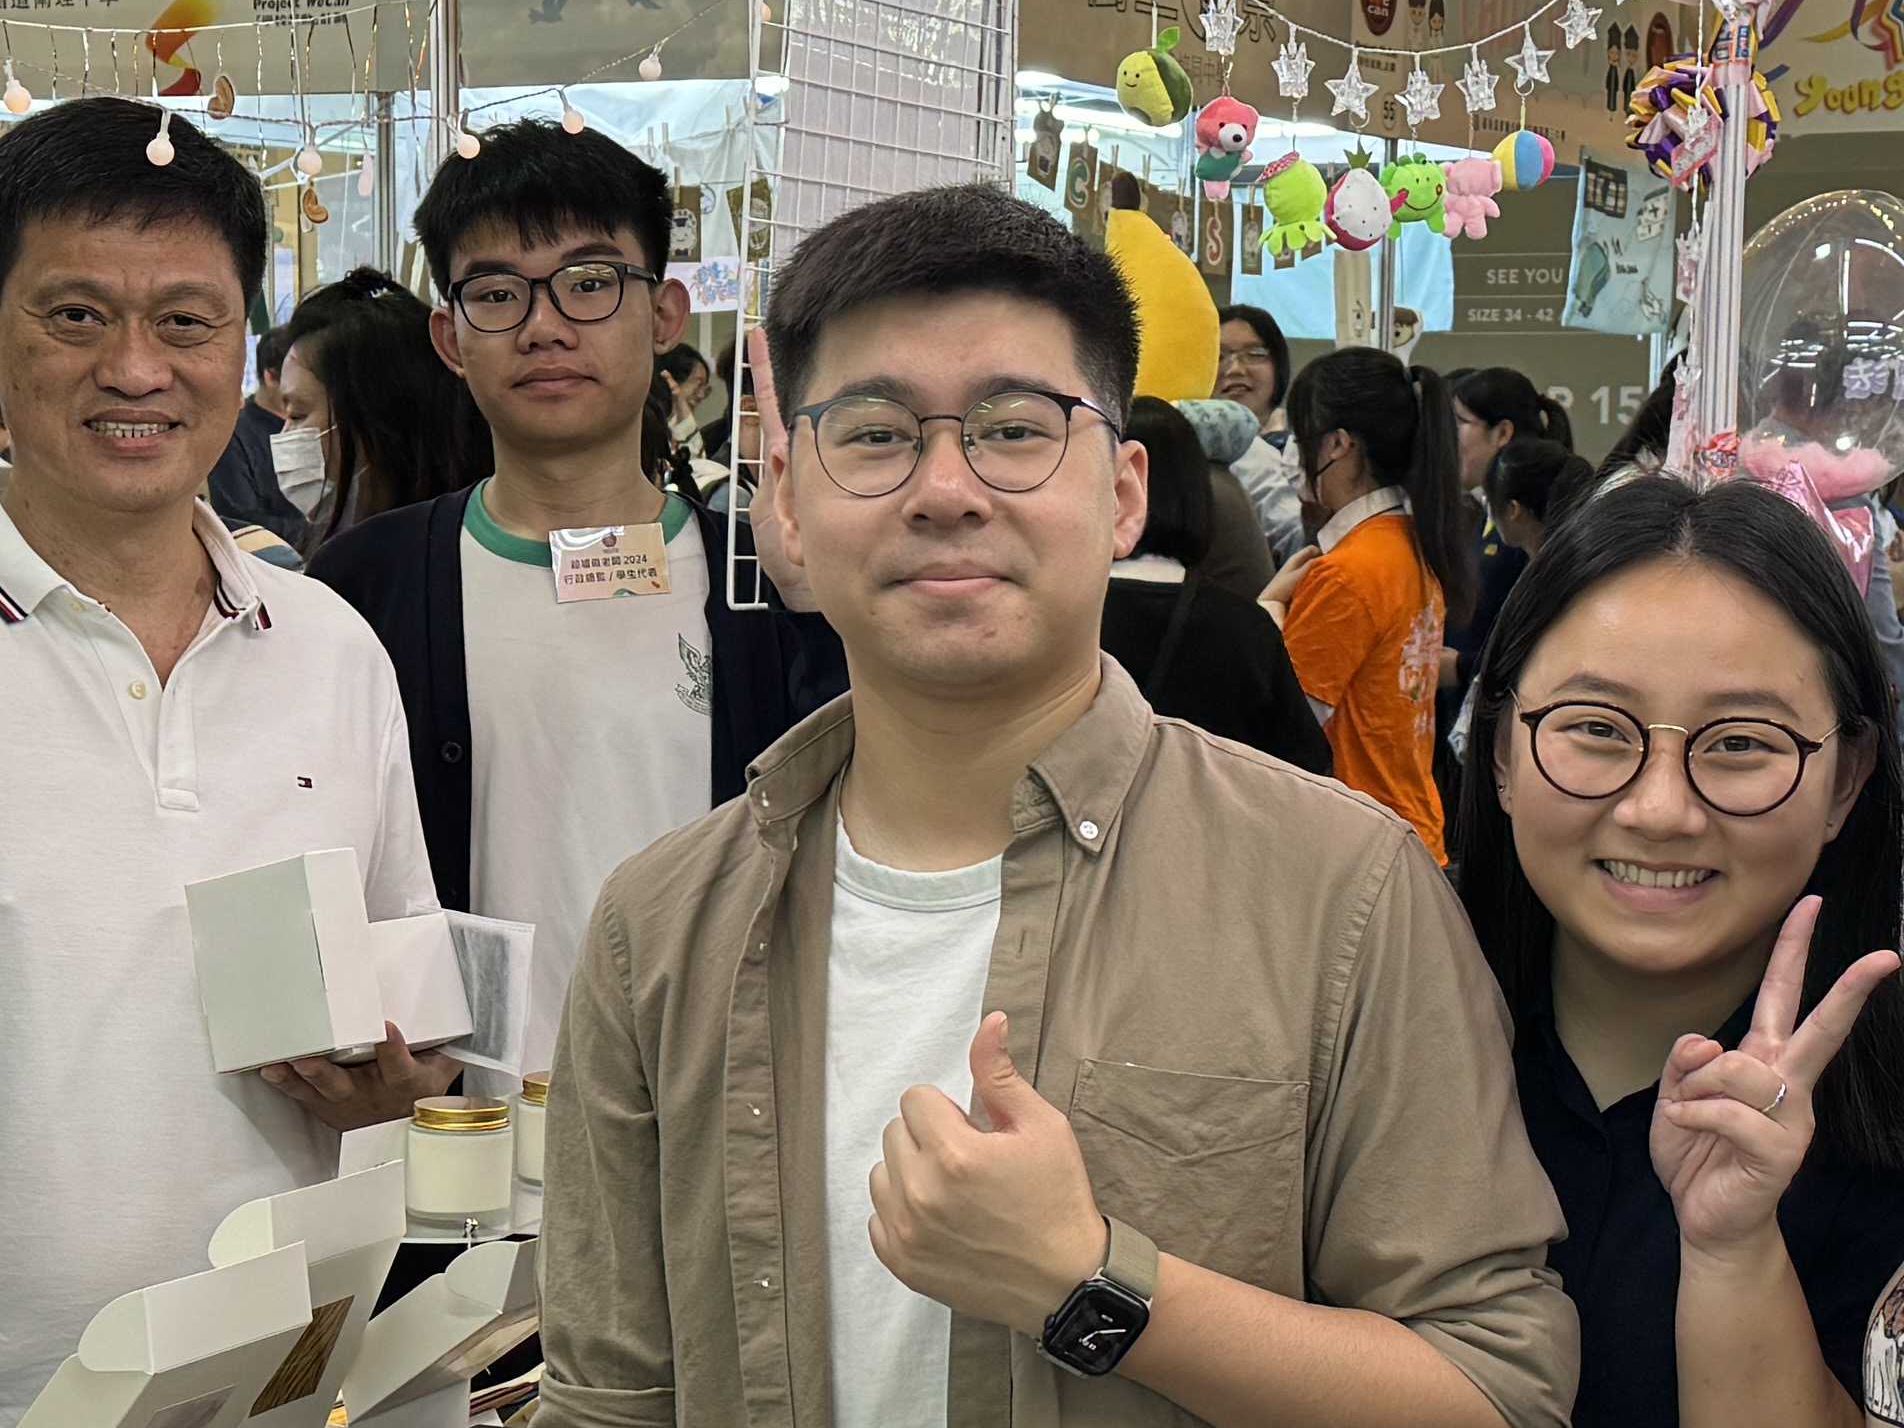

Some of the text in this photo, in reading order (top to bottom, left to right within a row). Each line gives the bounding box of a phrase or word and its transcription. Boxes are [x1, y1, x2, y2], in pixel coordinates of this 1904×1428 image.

[1382, 98, 1396, 122] 55
[1486, 267, 1564, 285] SEE YOU
[1468, 307, 1501, 322] SIZE
[1503, 307, 1522, 321] 34
[1534, 307, 1554, 321] 42
[623, 554, 648, 565] 2024
